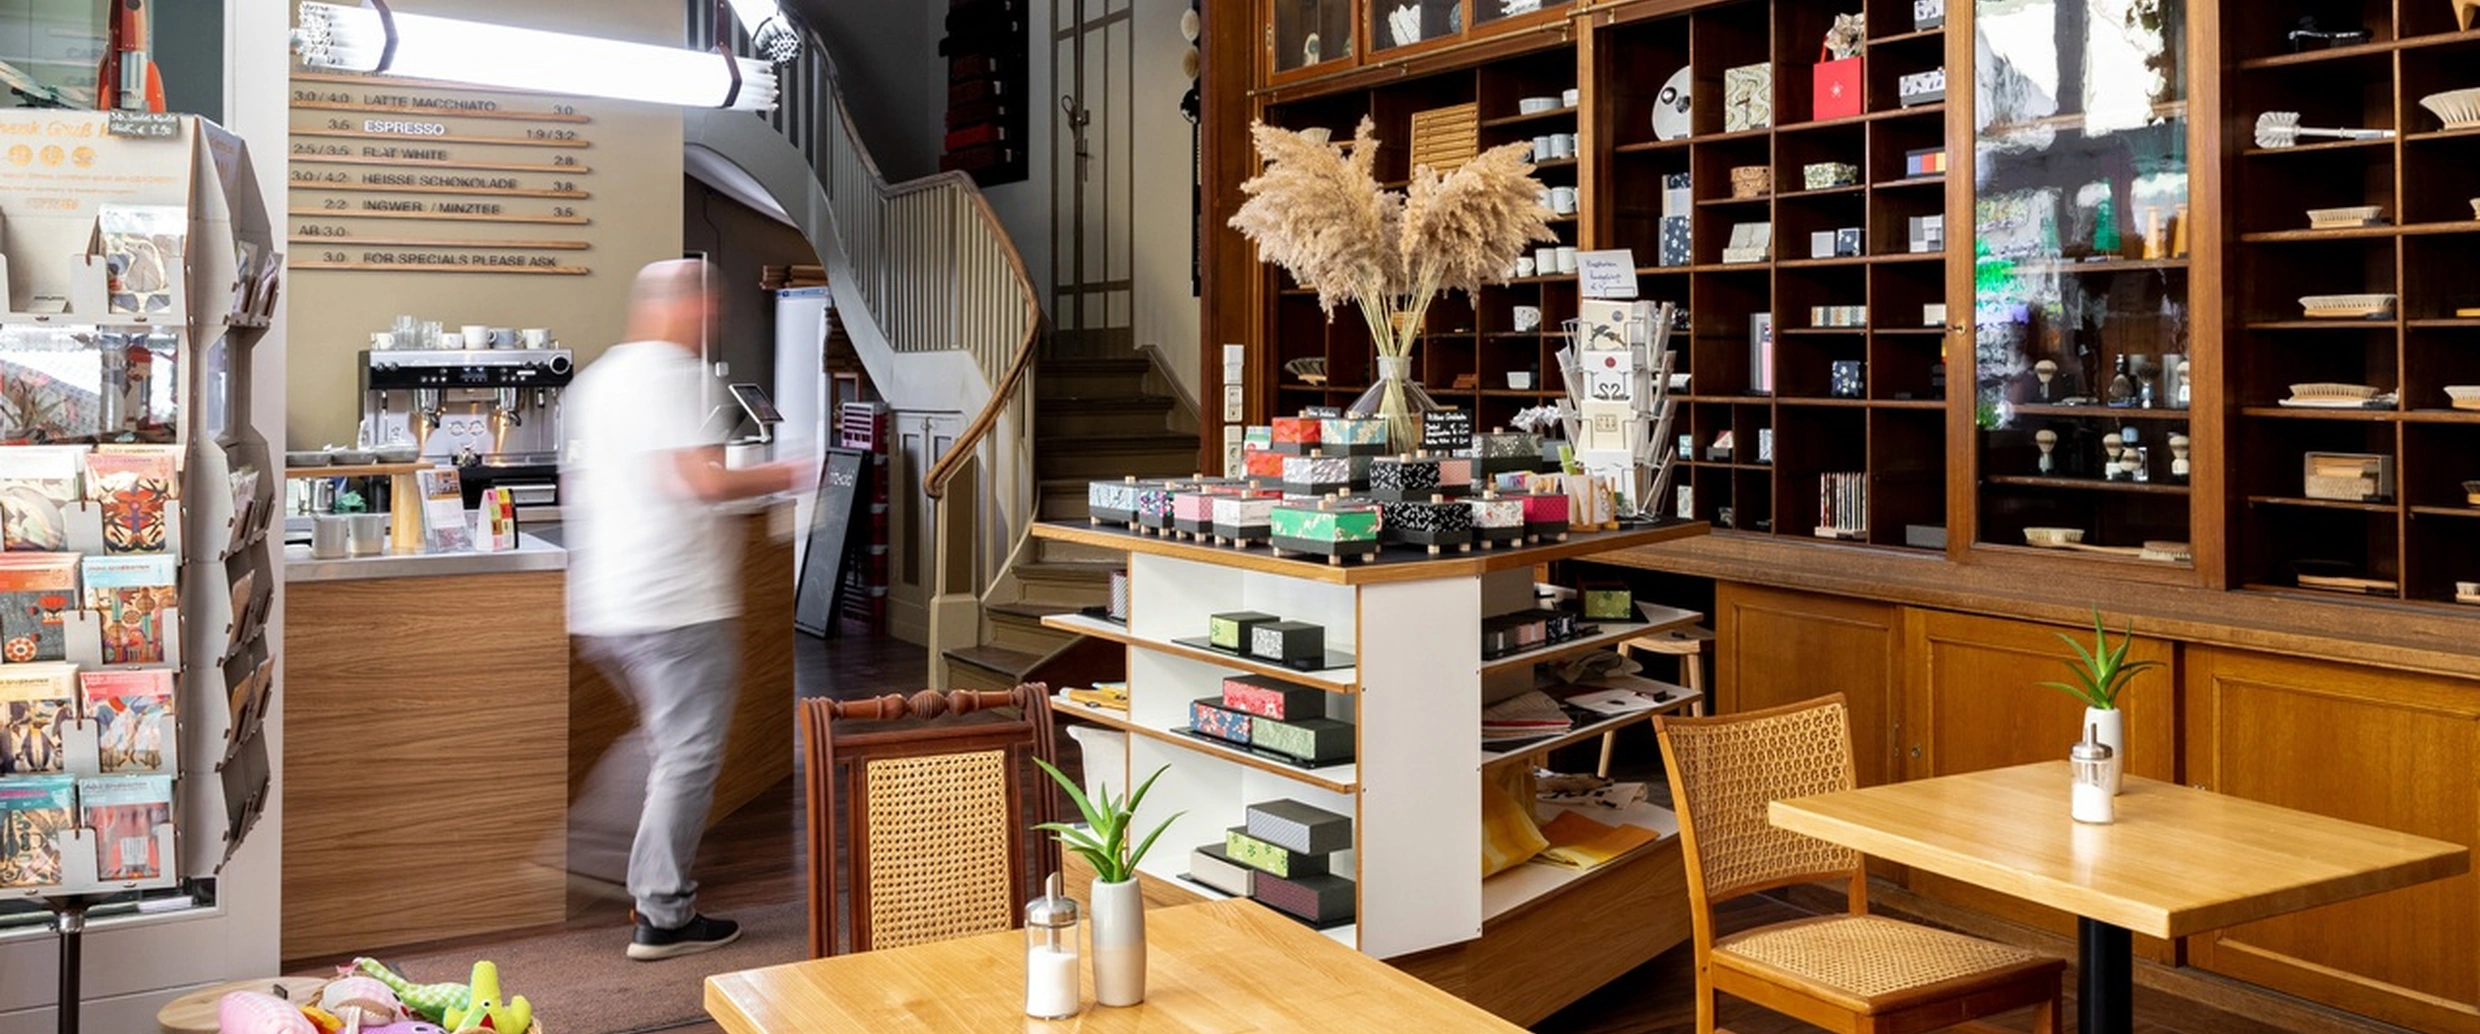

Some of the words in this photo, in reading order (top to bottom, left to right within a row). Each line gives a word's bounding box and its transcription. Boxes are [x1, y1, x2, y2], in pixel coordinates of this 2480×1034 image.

[294, 90, 316, 101] 3.0
[327, 92, 350, 103] 4.0
[364, 94, 407, 106] LATTE
[412, 96, 496, 111] MACCHIATO
[553, 105, 573, 116] 3.0
[328, 118, 350, 130] 3.5
[364, 119, 445, 136] ESPRESSO
[526, 129, 545, 139] 1.9
[555, 131, 574, 141] 3.2
[293, 143, 315, 155] 2.5
[327, 145, 350, 156] 3.5
[363, 147, 397, 158] FLAT
[401, 149, 447, 161] WHITE
[554, 155, 574, 166] 2.8
[291, 170, 313, 182] 3.0
[325, 172, 347, 183] 4.2
[362, 174, 415, 185] HEISSE
[420, 175, 517, 189] SCHOKOLADE
[553, 181, 574, 192] 3.8
[324, 198, 346, 210] 2.2
[439, 203, 500, 214] MINZTEE
[553, 206, 574, 217] 3.5
[299, 225, 319, 236] AB
[324, 226, 346, 237] 3.0
[323, 251, 346, 263] 3.0
[363, 252, 394, 264] FOR
[398, 253, 468, 266] SPECIALS
[472, 255, 526, 267] PLEASE
[528, 256, 556, 268] ASK
